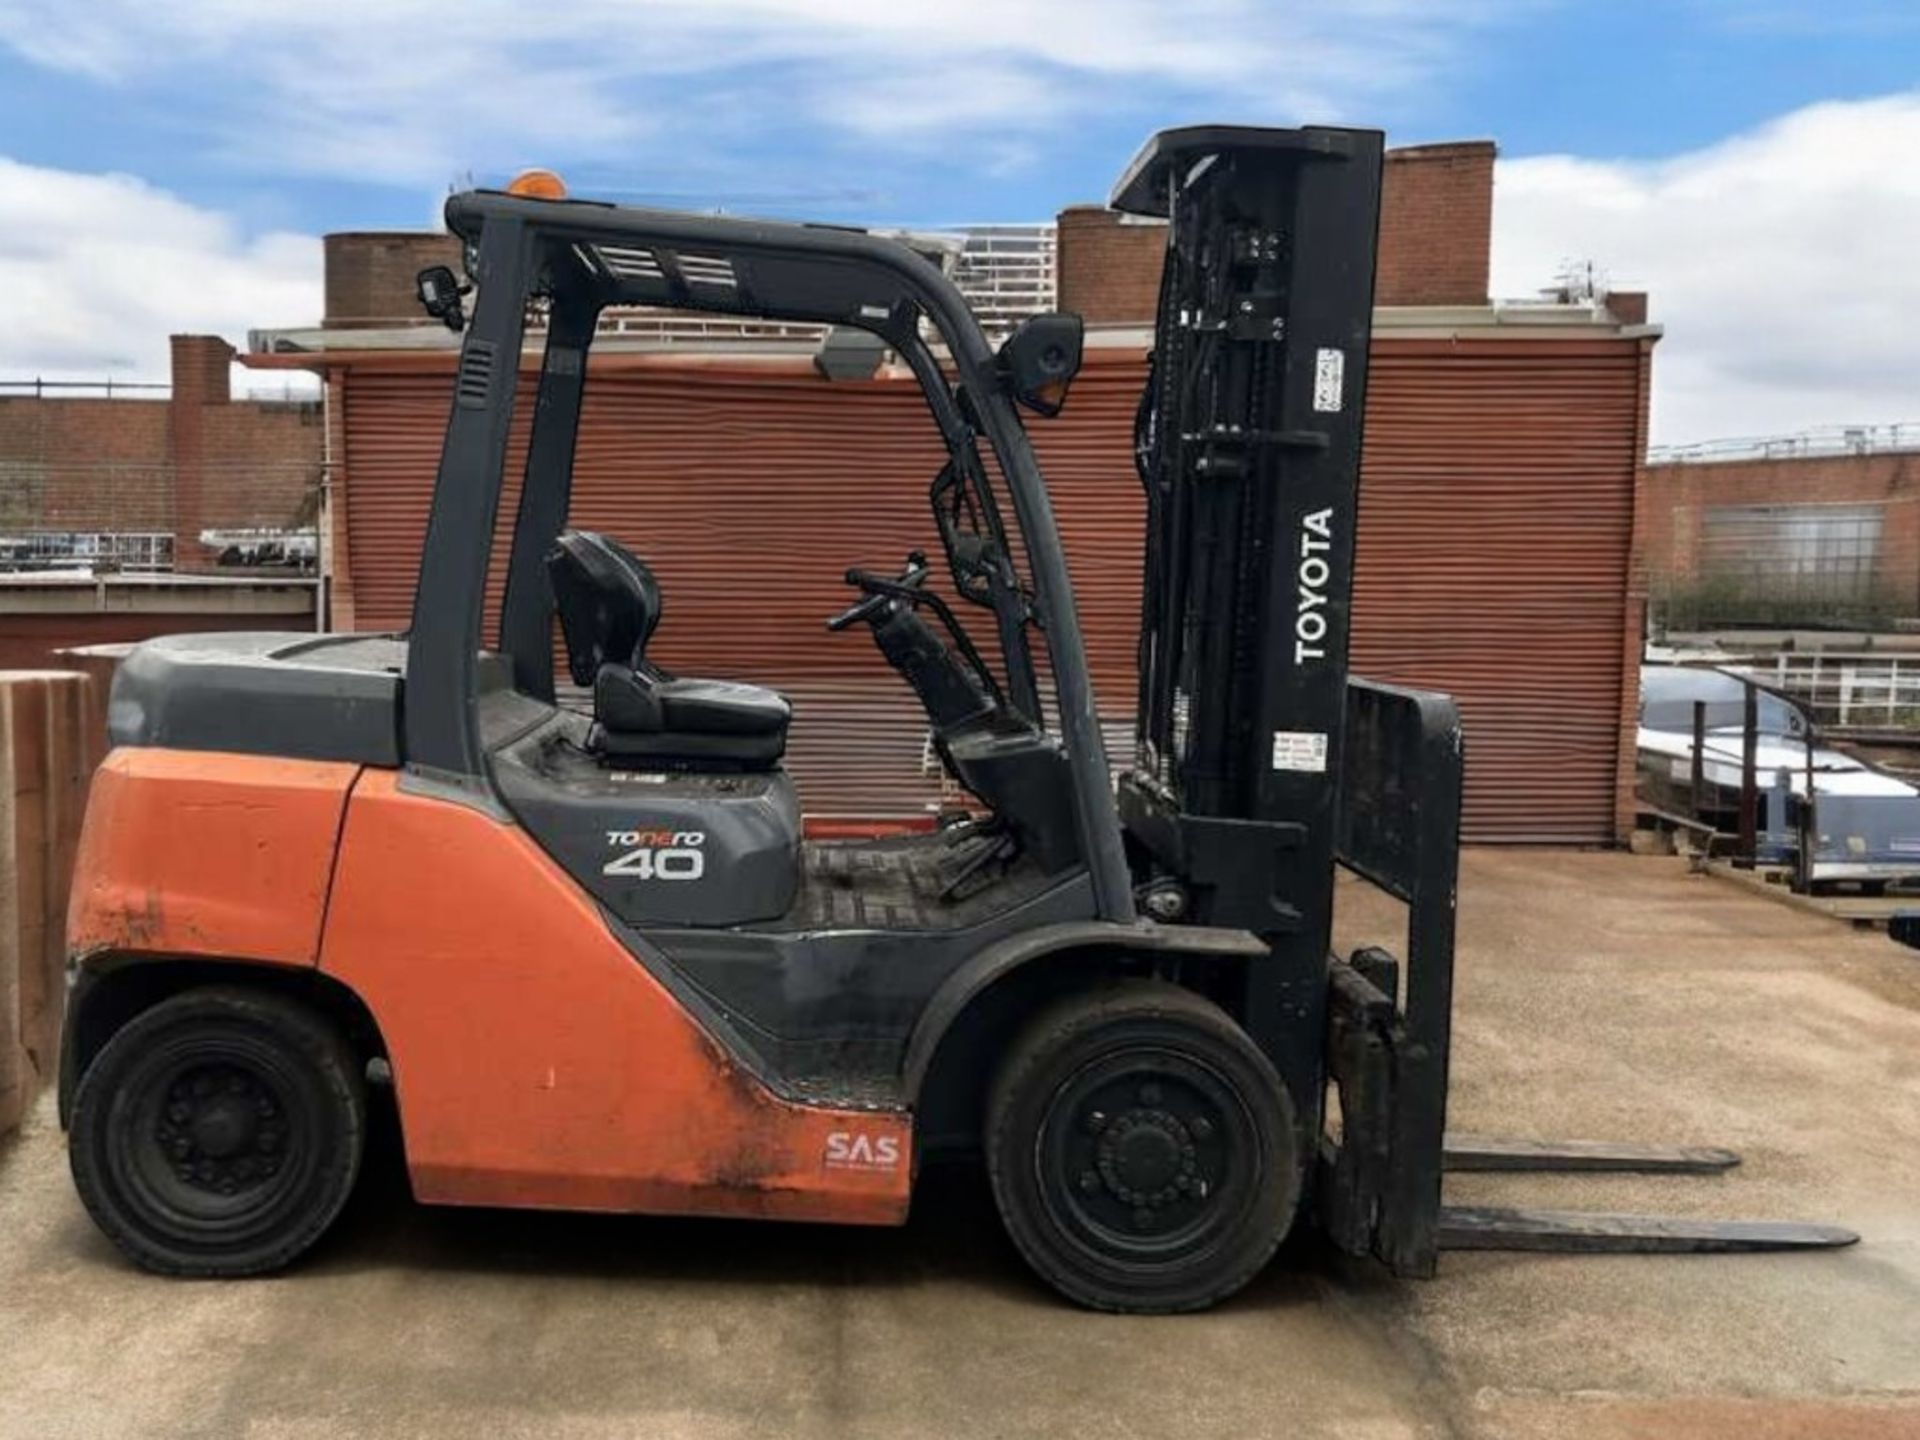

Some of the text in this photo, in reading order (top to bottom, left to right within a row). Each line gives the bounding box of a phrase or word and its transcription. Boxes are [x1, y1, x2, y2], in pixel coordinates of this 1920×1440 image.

[1295, 507, 1333, 665] TOYOTA
[603, 848, 704, 880] 40
[826, 1132, 899, 1163] SAS
